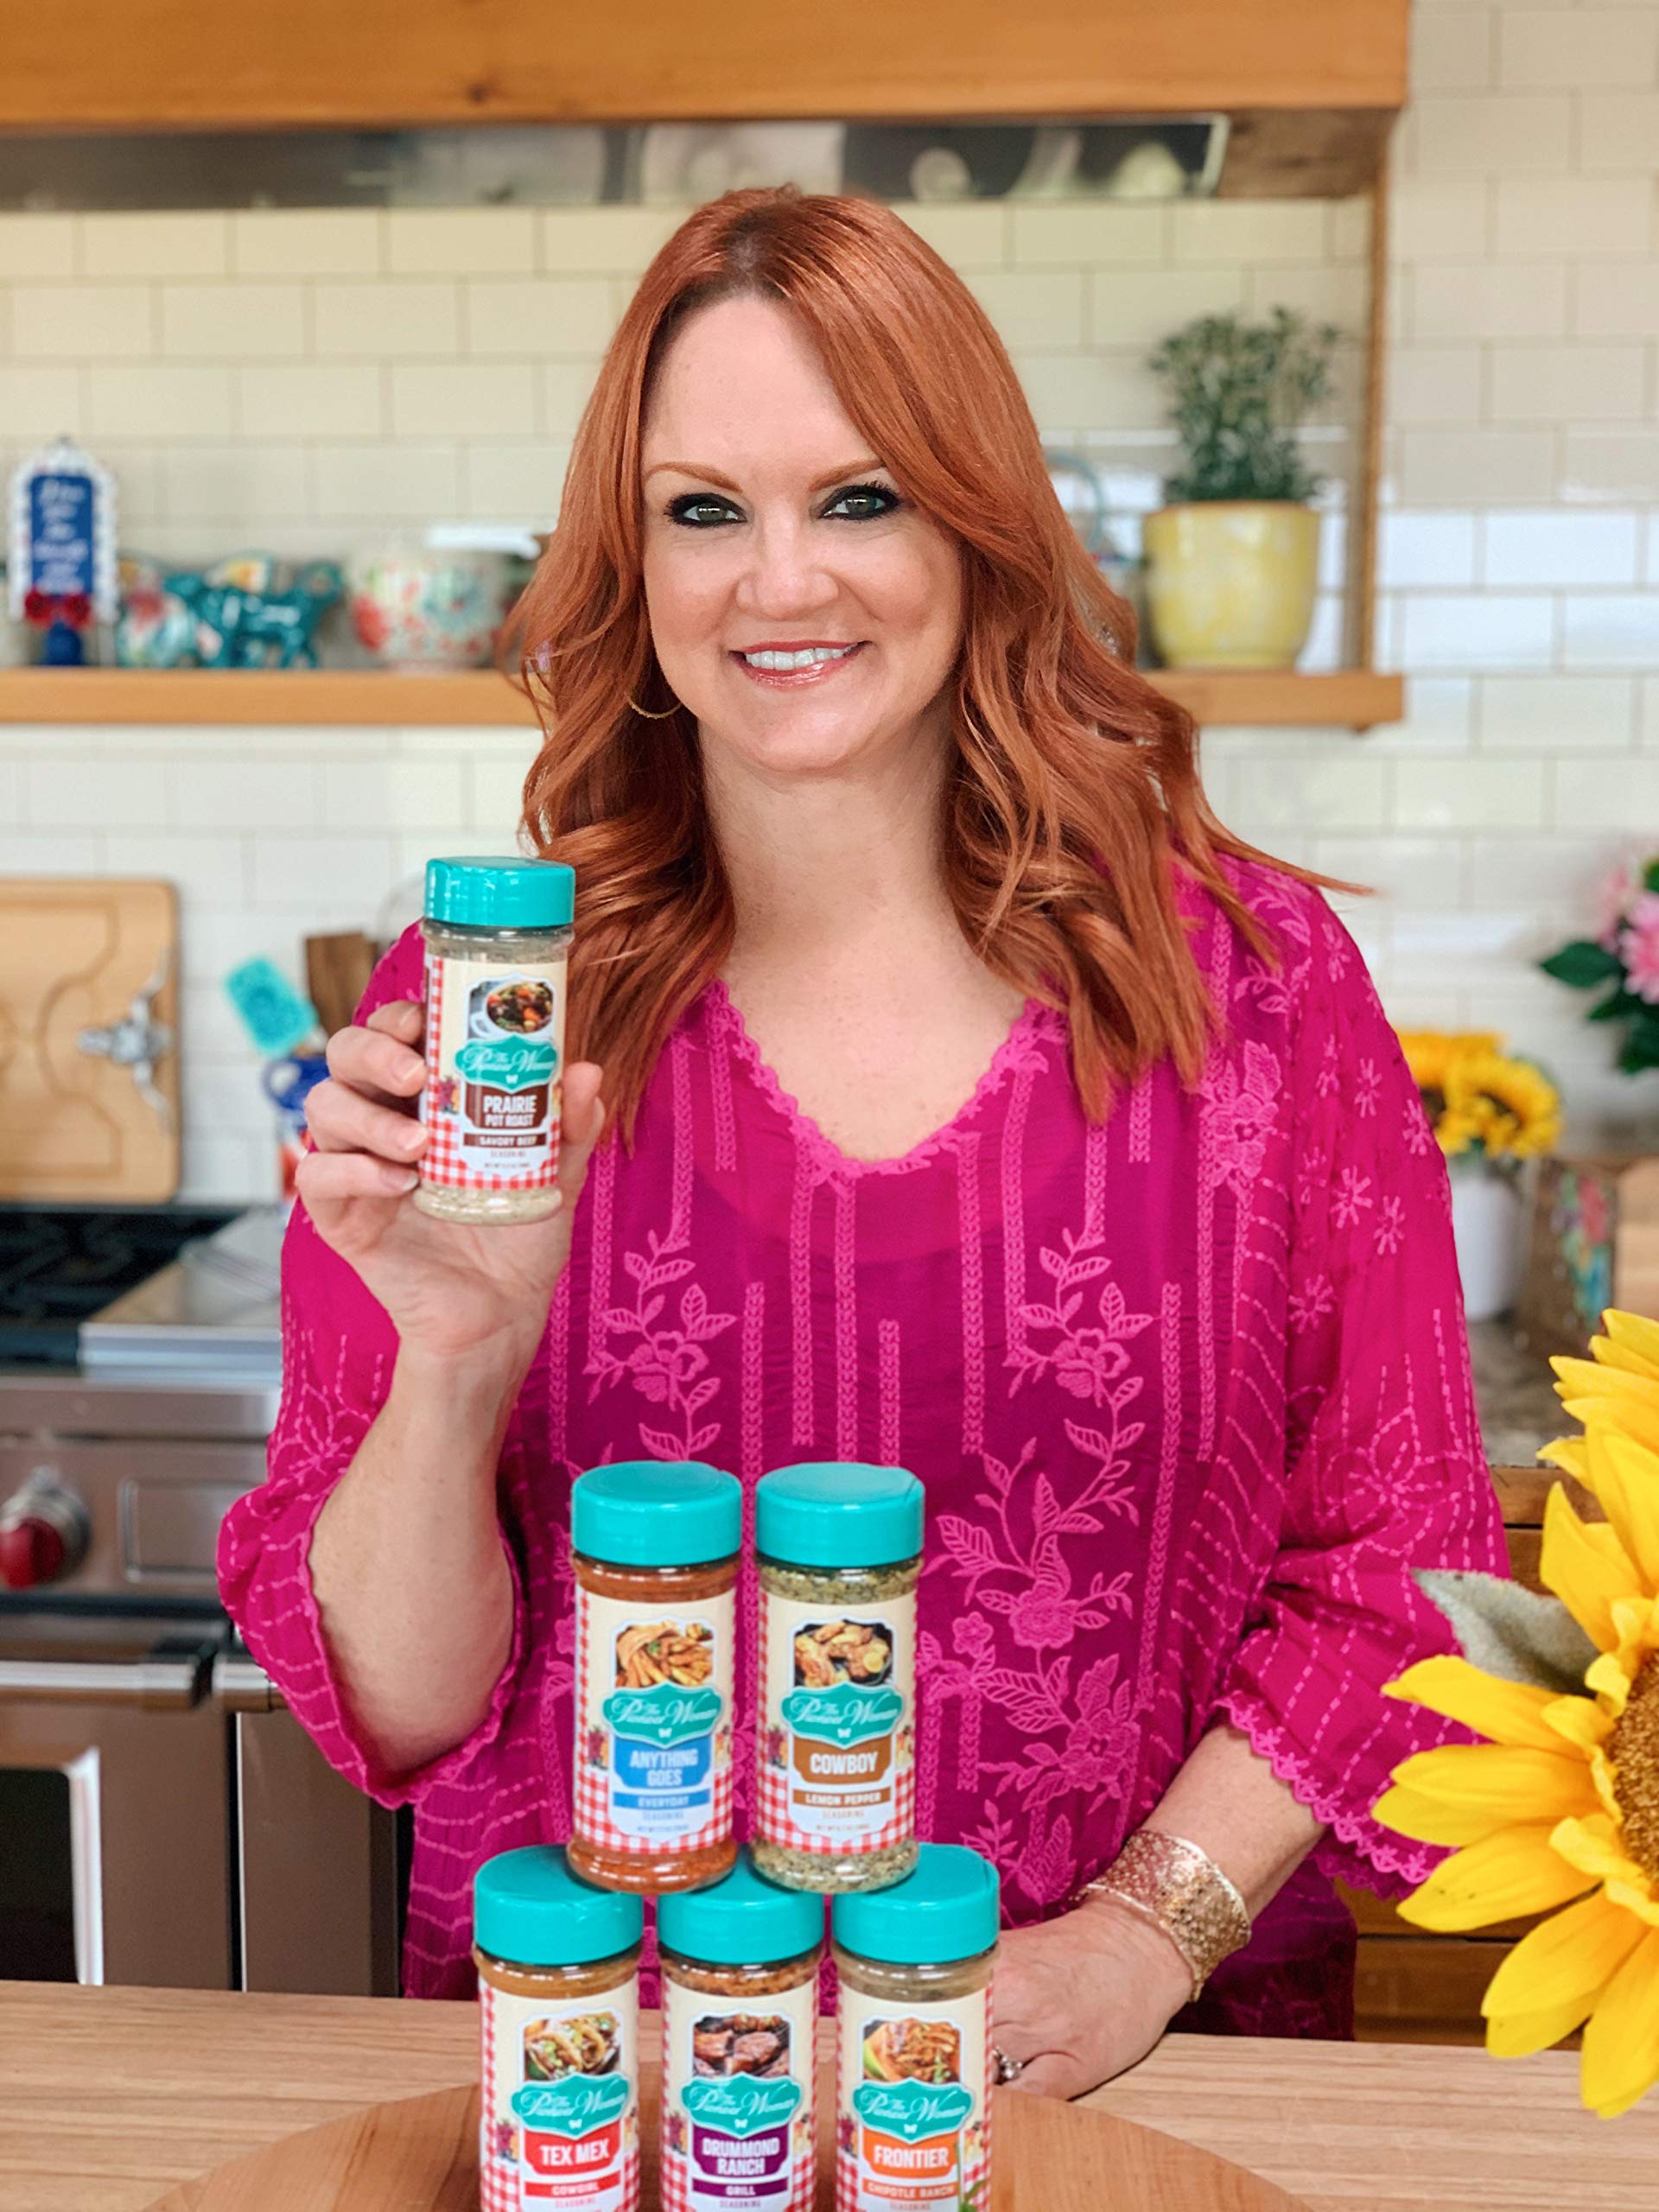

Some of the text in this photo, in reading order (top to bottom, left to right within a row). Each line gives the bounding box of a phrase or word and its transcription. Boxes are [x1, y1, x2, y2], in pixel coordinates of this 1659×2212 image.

[484, 1095, 537, 1113] PRAIRIE
[485, 1114, 534, 1127] POT ROAST
[480, 1136, 515, 1147] SAVORY
[629, 1748, 698, 1770] ANYTHING
[810, 1751, 879, 1775] COWBOY
[646, 1769, 683, 1787] GOES
[638, 1796, 690, 1808] EVERYDAY
[805, 1791, 881, 1806] LEMON PEPPER
[539, 2138, 610, 2166] TEX MEX
[702, 2137, 781, 2158] DRUMMOND
[874, 2144, 950, 2170] FRONTIER
[717, 2157, 766, 2176] RANCH
[551, 2181, 600, 2196] COWGIRL
[726, 2185, 757, 2196] GRILL
[868, 2181, 956, 2199] CHIPOTLE RANCH
